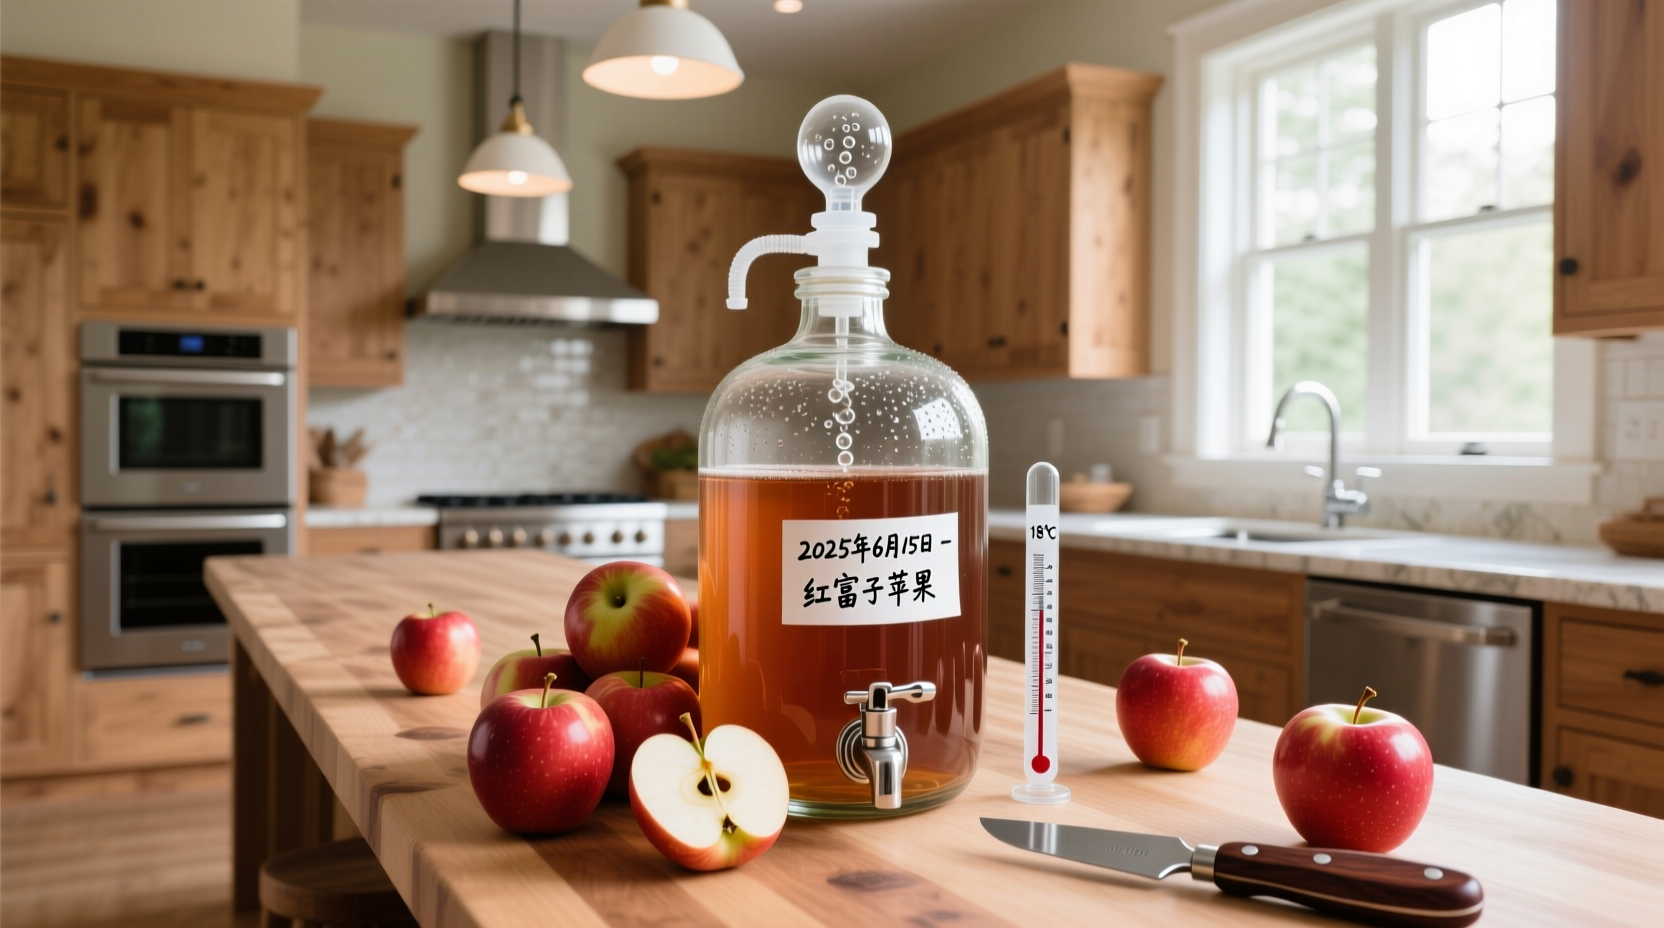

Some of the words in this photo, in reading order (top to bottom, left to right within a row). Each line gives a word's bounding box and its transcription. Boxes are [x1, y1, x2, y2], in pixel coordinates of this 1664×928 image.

[803, 569, 936, 609] 红富子苹果
